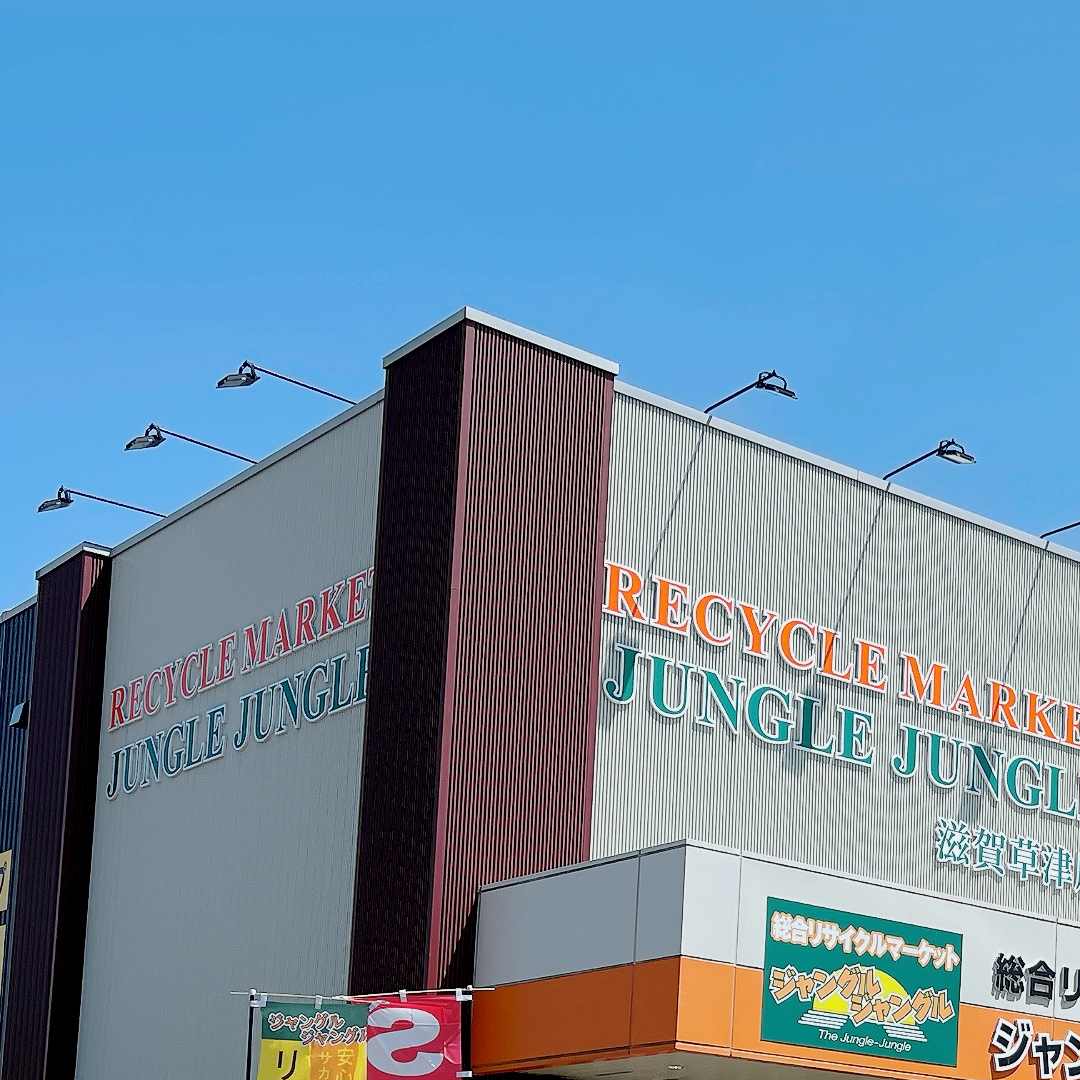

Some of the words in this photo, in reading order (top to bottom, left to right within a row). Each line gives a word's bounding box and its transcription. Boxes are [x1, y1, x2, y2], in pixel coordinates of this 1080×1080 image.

[601, 560, 887, 694] RECYCLE
[107, 632, 237, 732] RECYCLE
[603, 643, 874, 767] JUNGLE
[106, 705, 226, 801] JUNGLE
[770, 911, 961, 972] 総合リサイクルマーケット
[770, 963, 882, 1004] ジャングル
[849, 988, 956, 1027] ジャングル
[268, 1011, 345, 1032] ジャングル
[818, 1028, 838, 1041] The
[840, 1033, 912, 1053] Jungle-Jungle
